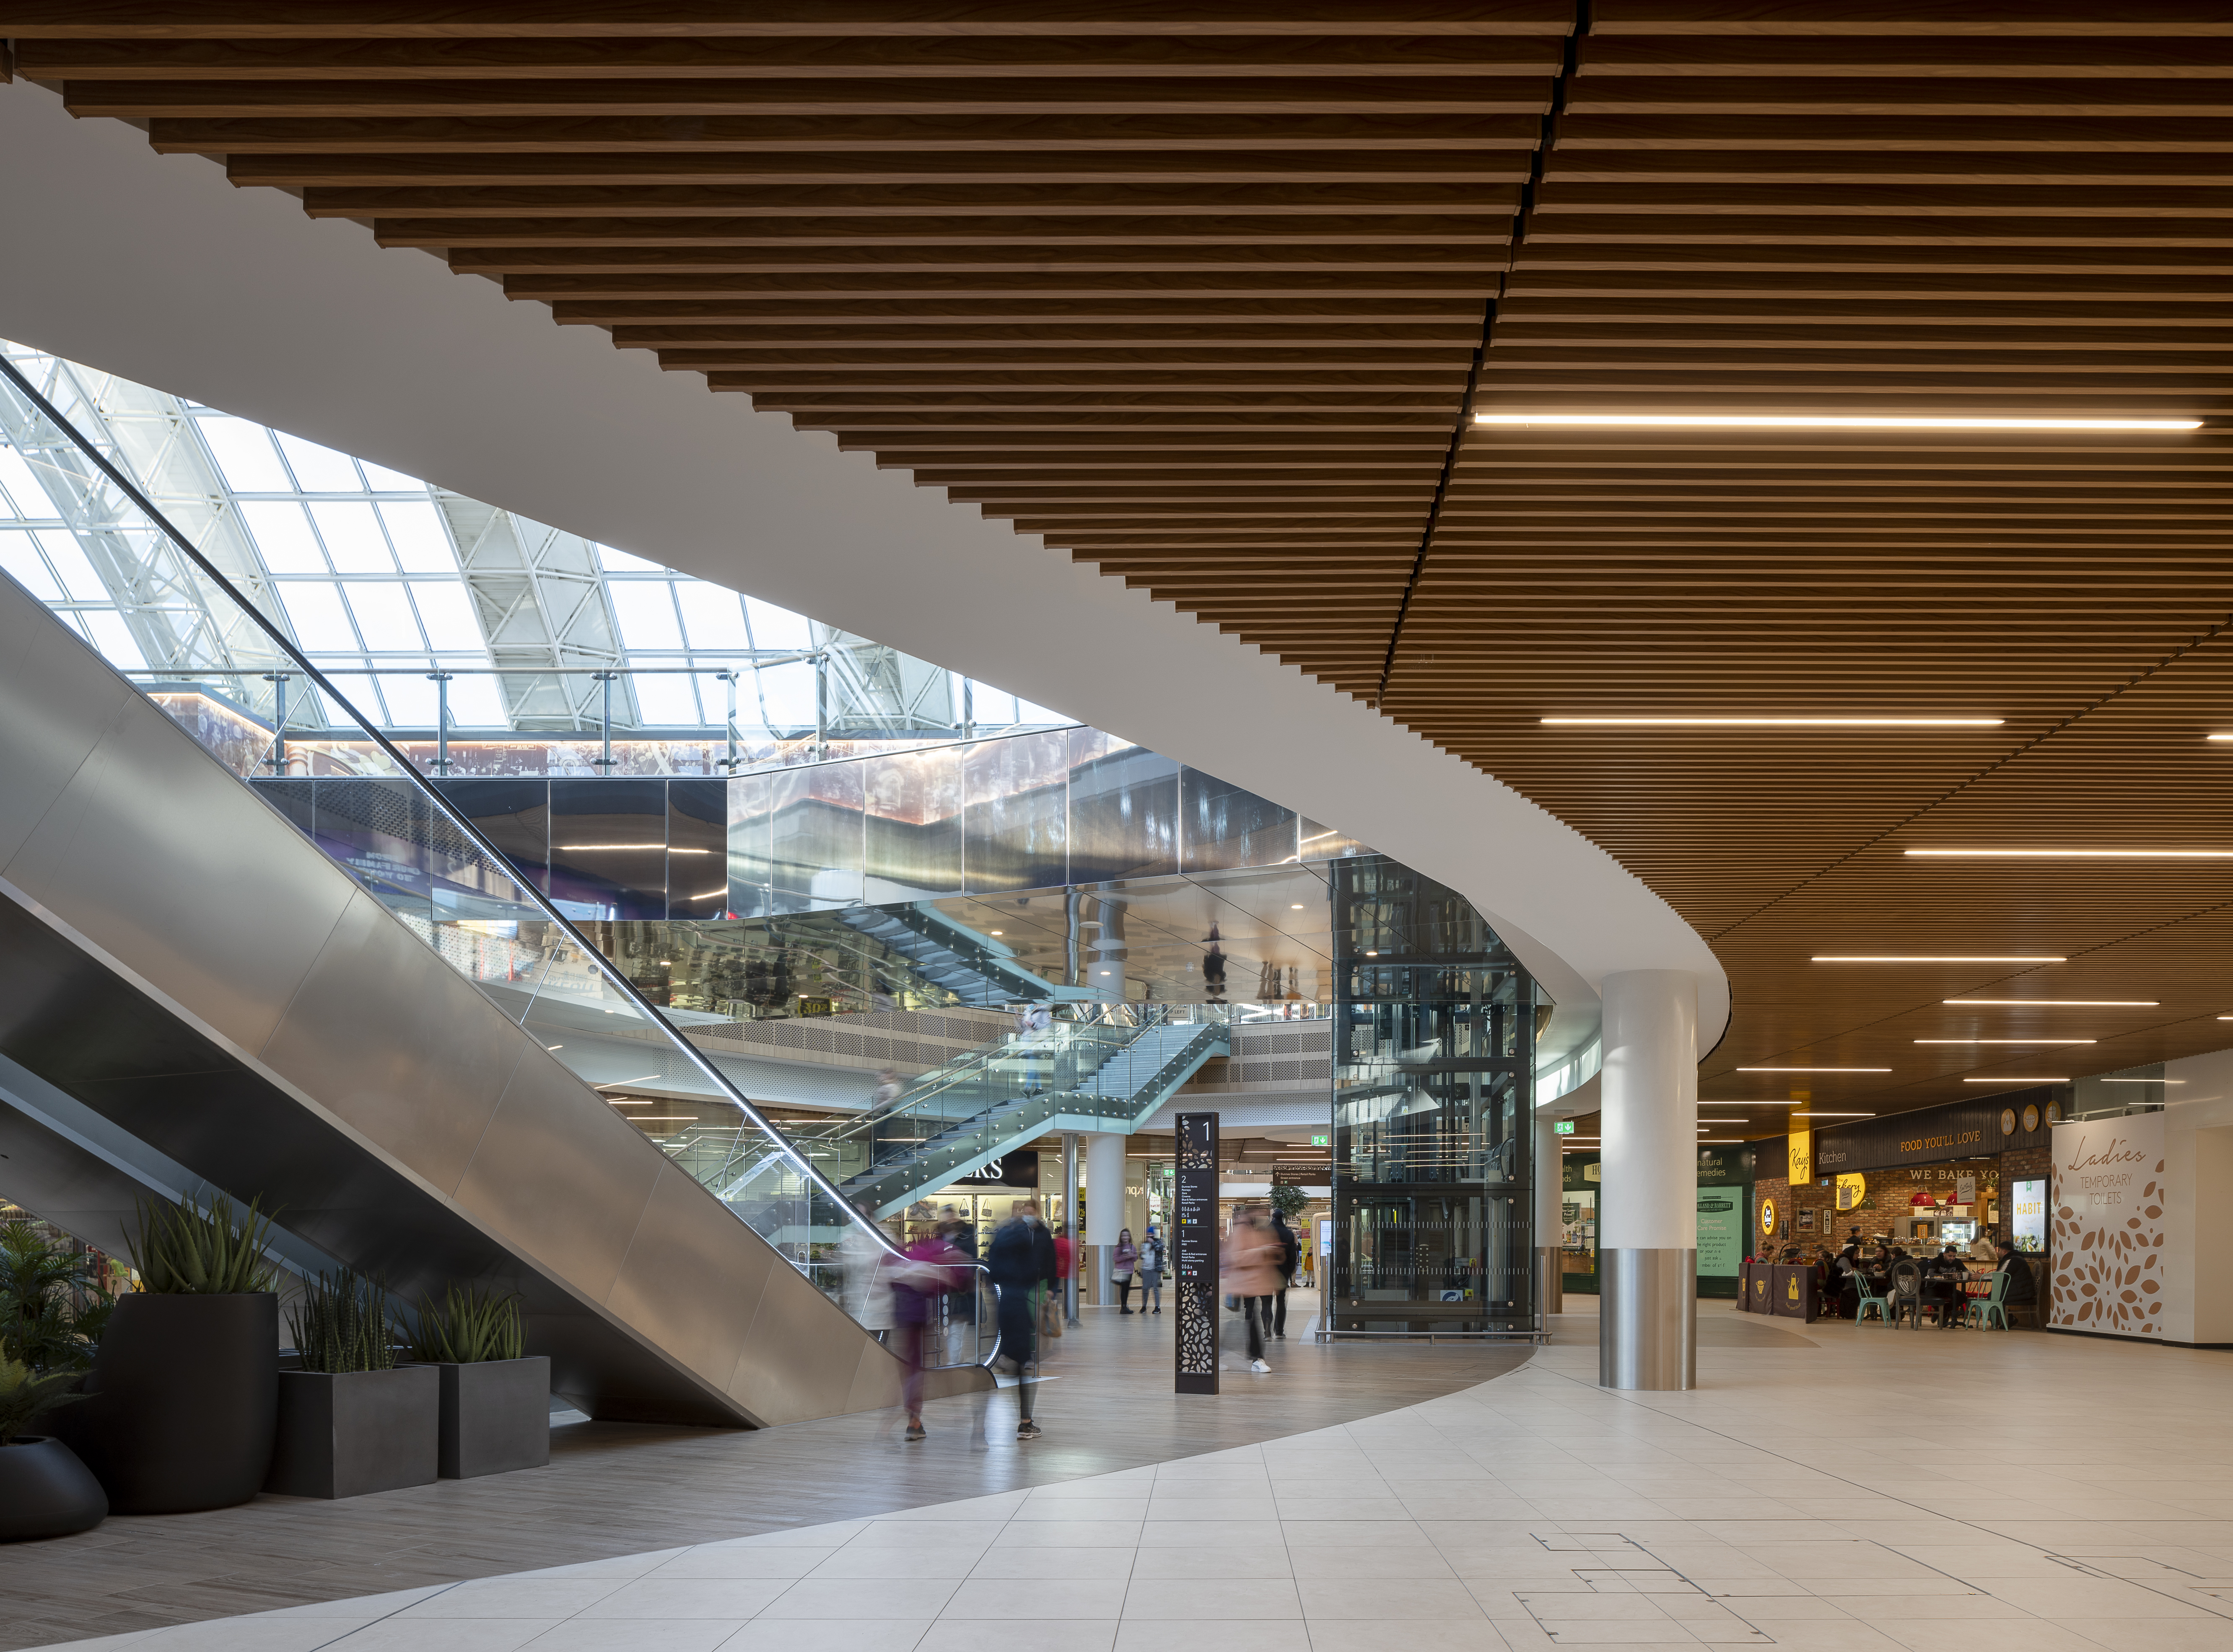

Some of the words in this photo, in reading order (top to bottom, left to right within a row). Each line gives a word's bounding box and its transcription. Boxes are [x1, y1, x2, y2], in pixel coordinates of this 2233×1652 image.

[1203, 1121, 1209, 1141] 1
[1901, 1139, 1922, 1152] FOOD
[1925, 1135, 1954, 1149] YOU'LL
[1957, 1130, 1981, 1144] LOVE
[1819, 1151, 1847, 1164] Kitchen
[2068, 1135, 2146, 1171] Ladies
[965, 1158, 1002, 1179] RS
[1697, 1157, 1722, 1166] natural
[1790, 1147, 1809, 1180] Kay's
[1696, 1168, 1726, 1177] emedies
[1910, 1170, 1931, 1180] WE
[1836, 1179, 1861, 1198] akery
[2080, 1173, 2133, 1189] TEMPORARY
[2089, 1191, 2121, 1205] TOILETS
[2017, 1202, 2041, 1215] HABIT
